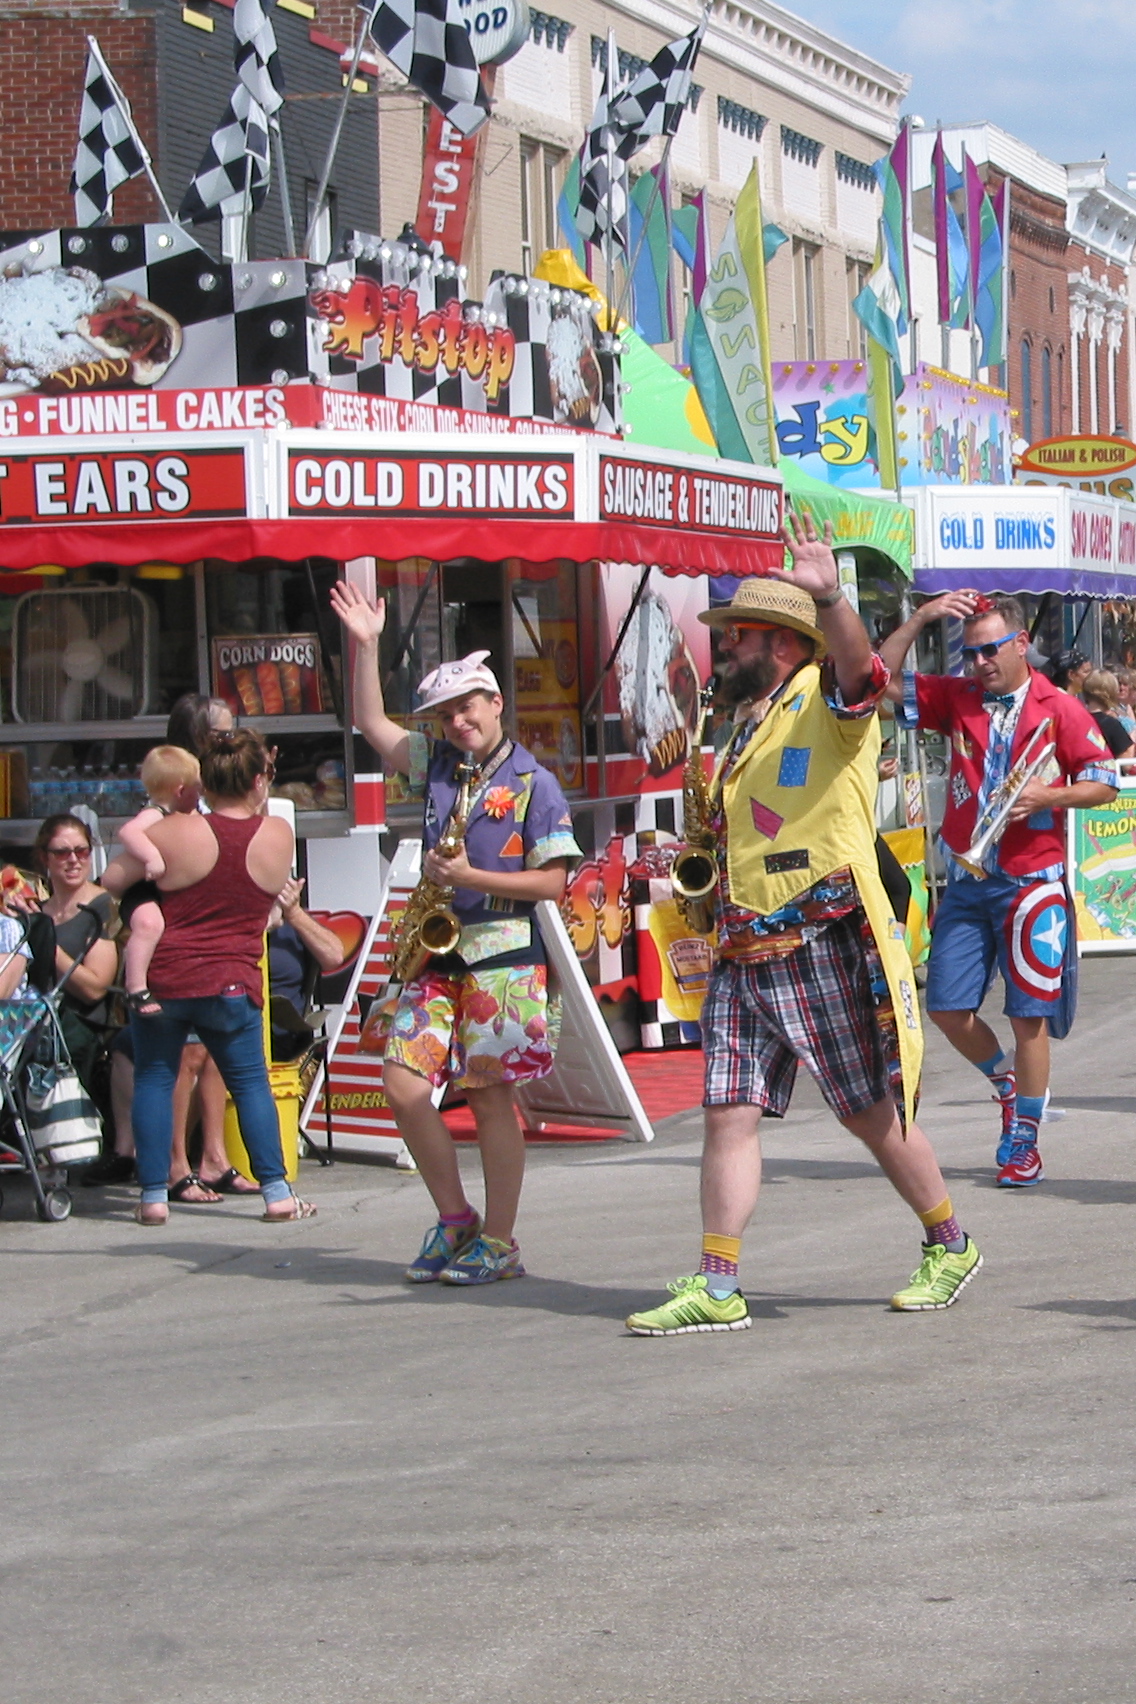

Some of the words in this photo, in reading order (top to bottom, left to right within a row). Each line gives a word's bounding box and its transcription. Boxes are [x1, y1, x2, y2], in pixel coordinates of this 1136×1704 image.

[312, 276, 516, 404] Pitstop
[39, 394, 167, 435] FUNNEL
[176, 389, 286, 430] CAKES
[322, 391, 369, 431] CHEESE
[370, 397, 400, 432] STIX
[1038, 447, 1076, 463] ITALIAN
[1091, 446, 1127, 463] POLISH
[34, 456, 191, 516] EARS
[294, 458, 404, 507] COLD
[418, 462, 568, 511] DRINKS
[604, 462, 674, 521] SAUSAGE
[678, 475, 690, 523] &
[693, 477, 779, 534] TENDERLOINS
[940, 512, 985, 550] COLD
[994, 512, 1056, 550] DRINKS
[220, 646, 266, 670] CORN
[270, 643, 314, 668] DOGS
[321, 1092, 391, 1111] ENDERL
